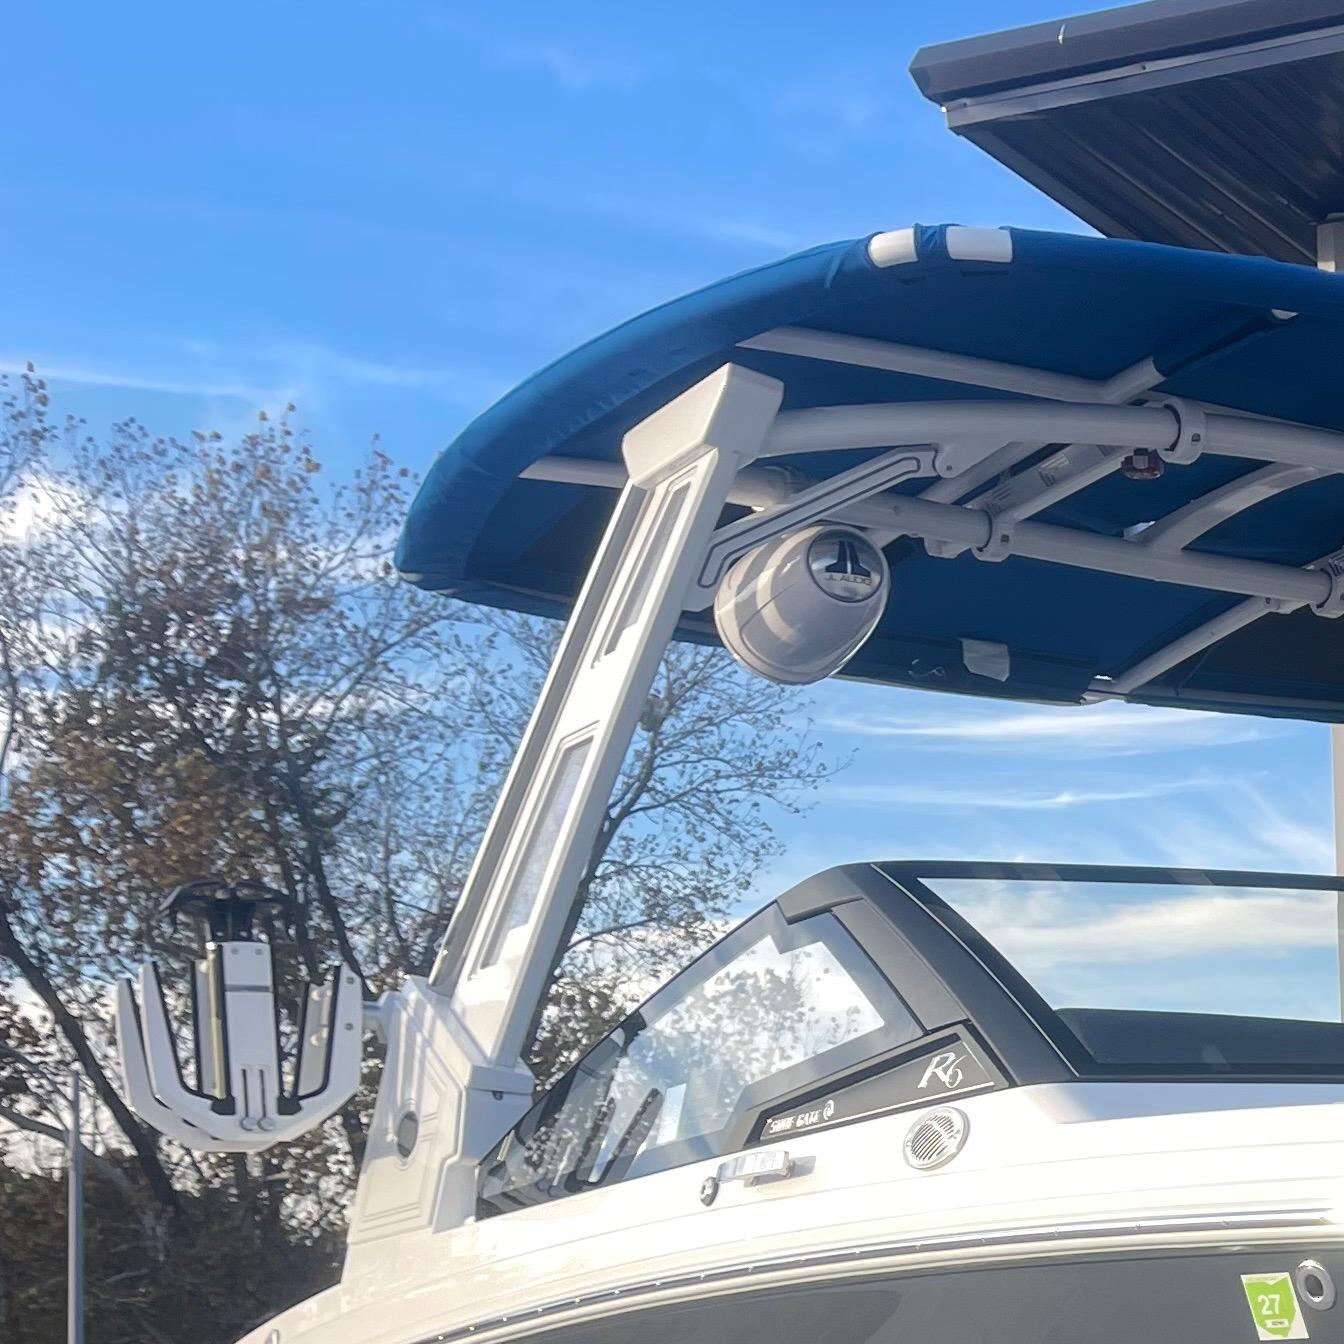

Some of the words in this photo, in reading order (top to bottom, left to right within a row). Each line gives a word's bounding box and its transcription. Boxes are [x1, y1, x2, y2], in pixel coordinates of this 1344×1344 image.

[839, 574, 873, 587] AUDIO
[917, 1052, 967, 1089] R6
[1257, 1293, 1281, 1316] 27
